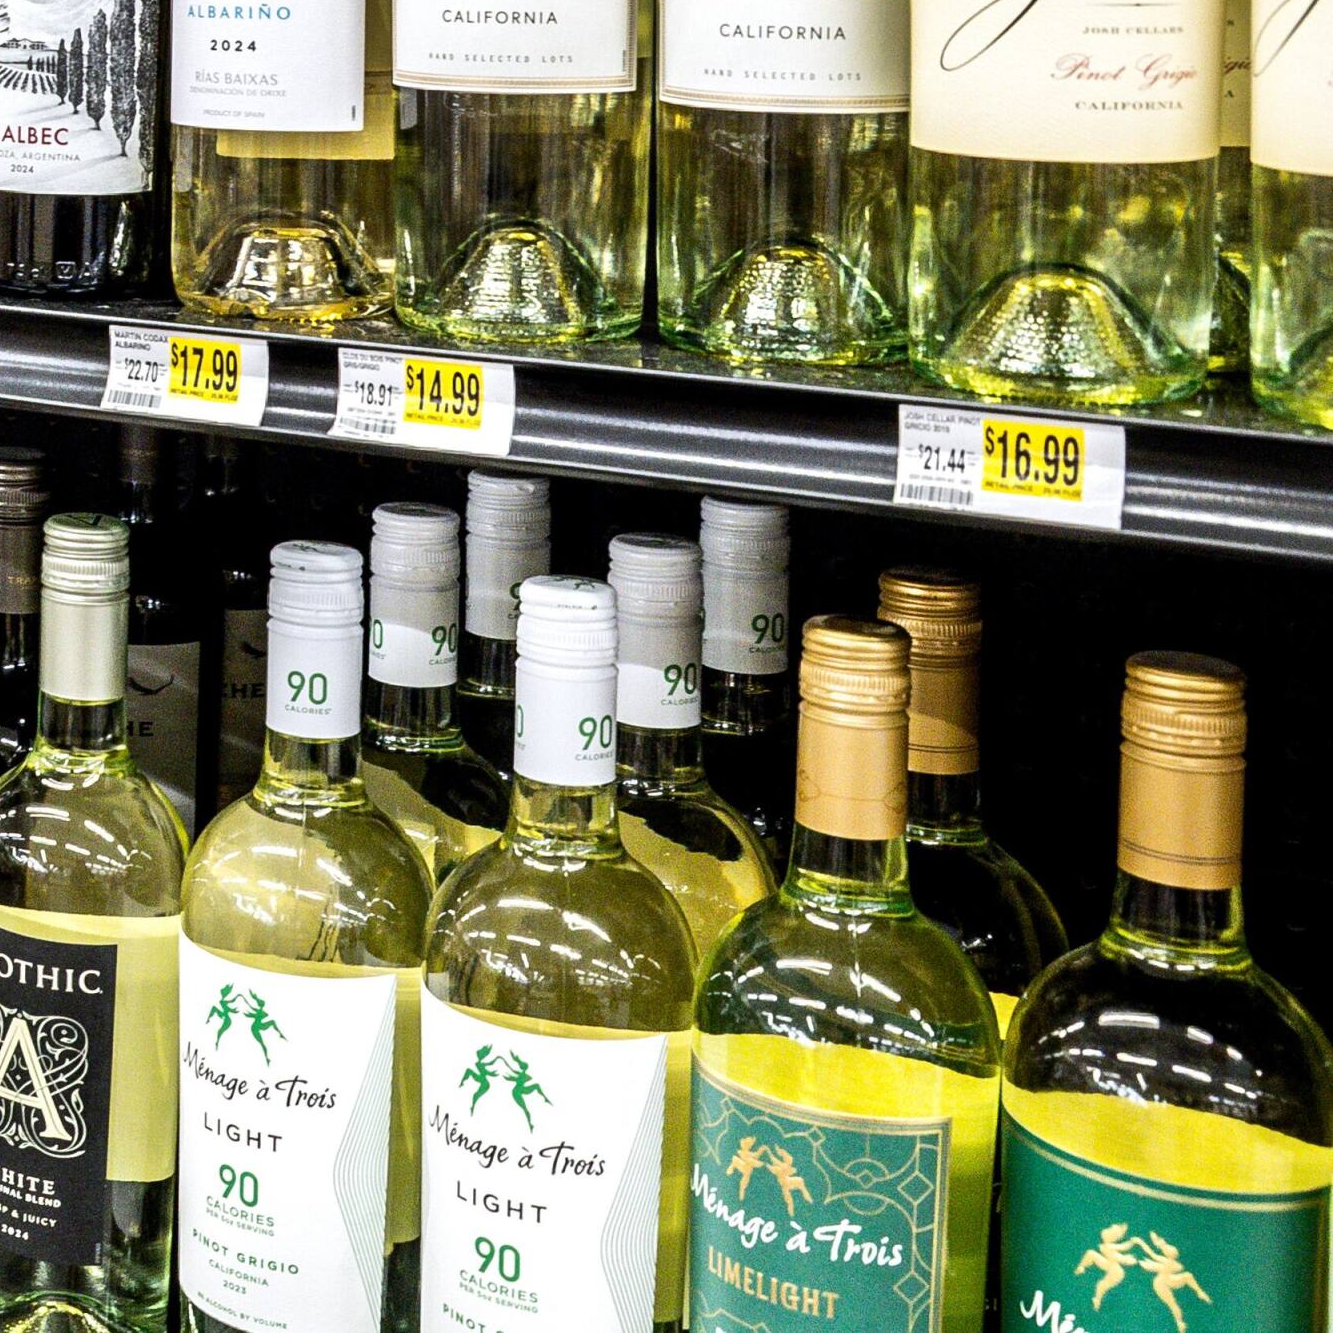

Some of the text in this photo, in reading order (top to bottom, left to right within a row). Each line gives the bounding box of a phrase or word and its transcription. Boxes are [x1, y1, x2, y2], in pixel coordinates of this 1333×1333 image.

[188, 2, 292, 21] ALBARIÑO
[442, 9, 558, 25] CALIFORNIA
[210, 40, 258, 52] 2024
[719, 24, 847, 41] CALIFORNIA
[464, 54, 531, 64] SELECTED
[541, 55, 574, 64] LOTS
[1050, 53, 1199, 91] Pinot Grigio
[195, 70, 279, 86] RÍAS BAIXAS
[1075, 100, 1184, 111] CALIFORNIA
[10, 163, 34, 174] 2024
[124, 358, 159, 384] $22.70
[171, 341, 239, 392] $17.99
[355, 381, 394, 407] $18.91
[406, 364, 481, 417] $14.99
[918, 443, 966, 474] $21.44
[985, 425, 1080, 486] $16.99
[751, 613, 785, 643] 90
[287, 670, 328, 704] 90
[664, 664, 697, 695] 90
[578, 714, 613, 750] 90
[183, 1042, 337, 1110] Ménage à Trois
[204, 1111, 283, 1153] LIGHT
[429, 1105, 607, 1176] Ménage à Trois
[25, 1194, 62, 1209] BLEND
[218, 1164, 259, 1208] 90
[457, 1180, 548, 1224] LIGHT
[22, 1214, 58, 1228] JUICY
[206, 1195, 276, 1228] CALORIES
[690, 1163, 903, 1268] Ménage à Trois
[1, 1224, 30, 1241] 2024
[192, 1229, 300, 1275] PINOT GRIGIO
[474, 1236, 521, 1282] 90
[208, 1258, 269, 1287] CALIFORNIA
[459, 1269, 539, 1304] CALORIES
[707, 1245, 841, 1320] LIMELIGHT
